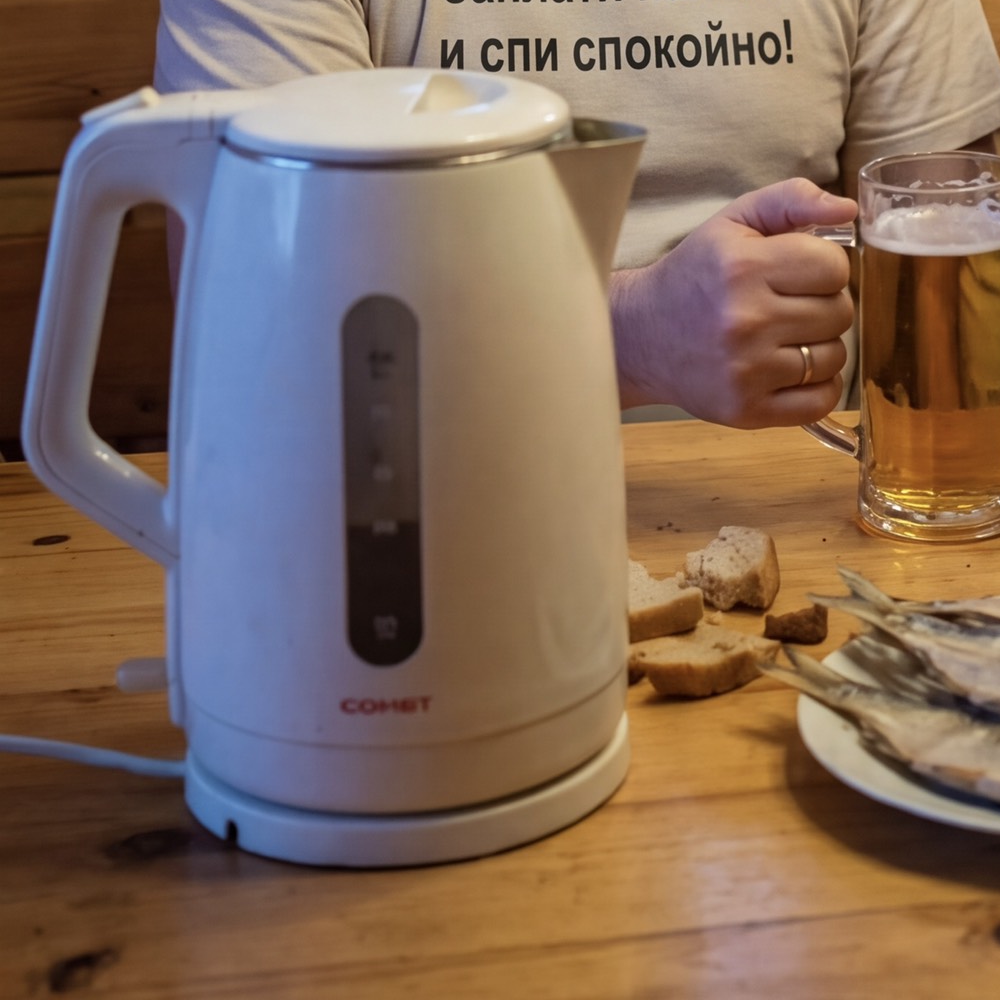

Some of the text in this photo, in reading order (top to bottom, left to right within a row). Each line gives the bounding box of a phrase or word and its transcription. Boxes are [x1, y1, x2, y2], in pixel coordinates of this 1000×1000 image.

[440, 19, 794, 72] и спи спокойно!
